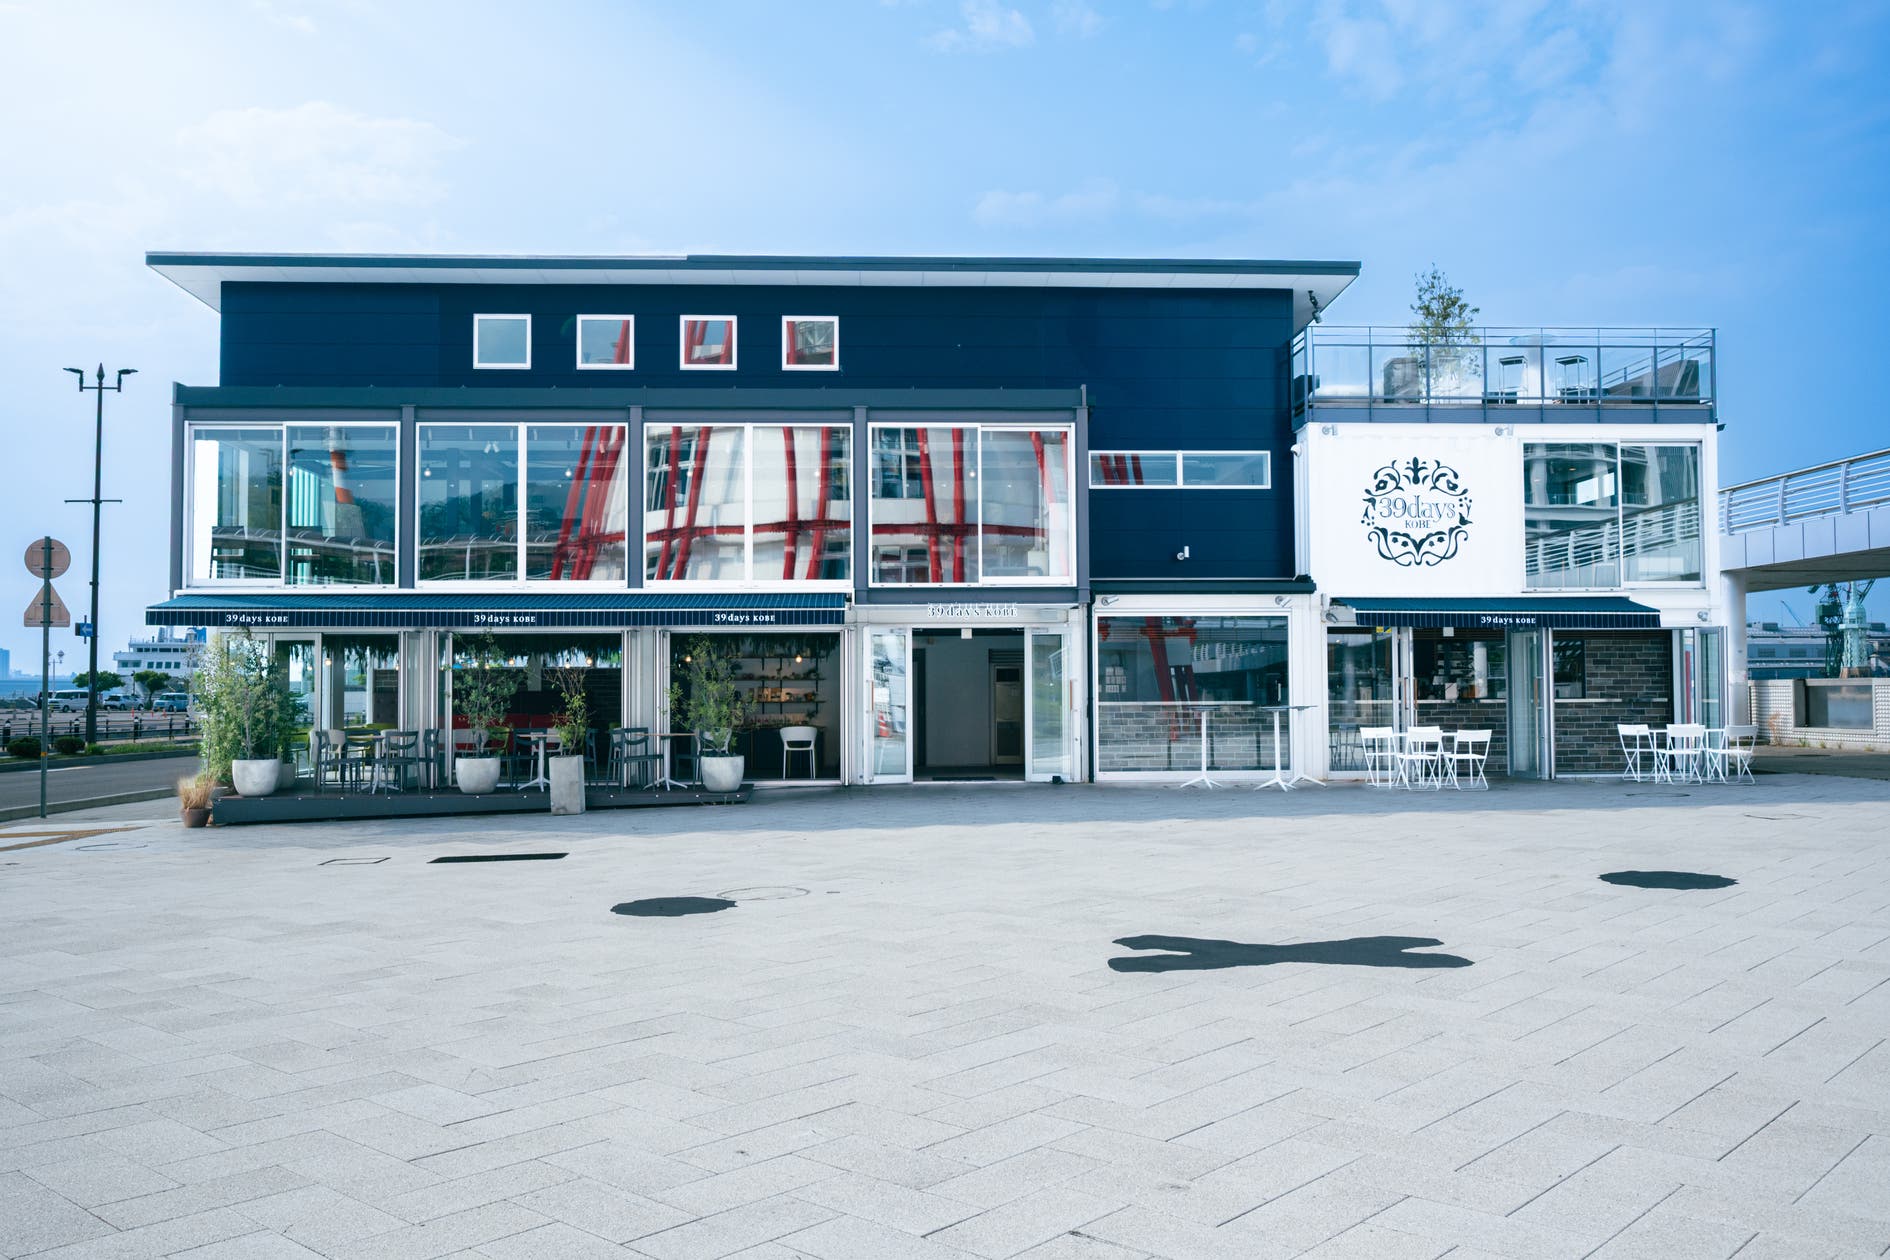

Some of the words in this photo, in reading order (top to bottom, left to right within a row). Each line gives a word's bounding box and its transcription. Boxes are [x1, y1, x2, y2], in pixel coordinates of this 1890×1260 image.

[1379, 495, 1456, 523] 39days
[1405, 520, 1431, 529] KOBE
[926, 605, 980, 619] 39days
[985, 607, 1018, 617] KOBE
[226, 614, 262, 624] 39days
[265, 615, 289, 623] KOBE
[474, 614, 510, 624] 39days
[714, 613, 750, 623] 39days
[753, 614, 776, 622] KOBE
[1481, 616, 1513, 625] 39days
